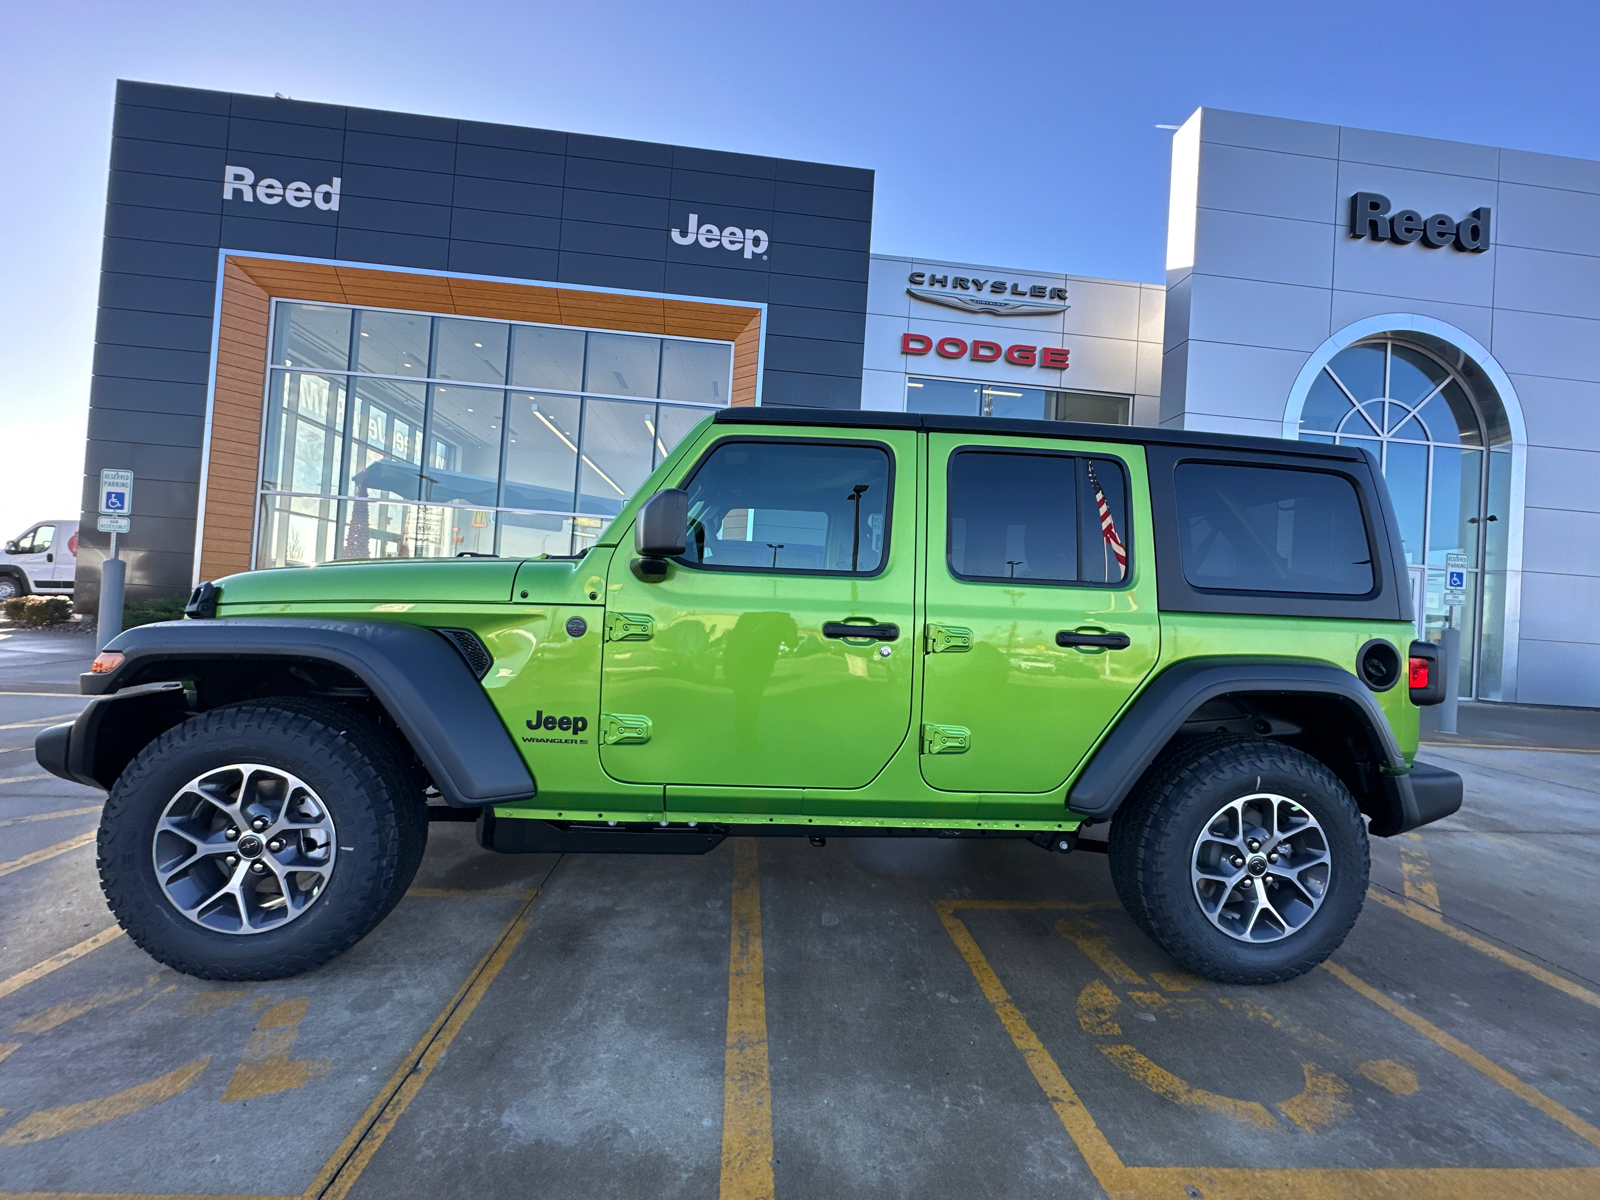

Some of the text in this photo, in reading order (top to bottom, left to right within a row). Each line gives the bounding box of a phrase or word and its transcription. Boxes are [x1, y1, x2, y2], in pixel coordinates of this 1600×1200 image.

[222, 164, 342, 212] Reed
[670, 213, 769, 260] Jeep
[1350, 191, 1491, 253] Reed
[908, 271, 1069, 300] CHRYSLER
[901, 332, 1071, 370] DODGE
[522, 736, 578, 744] WRANGLER
[526, 710, 588, 735] Jeep
